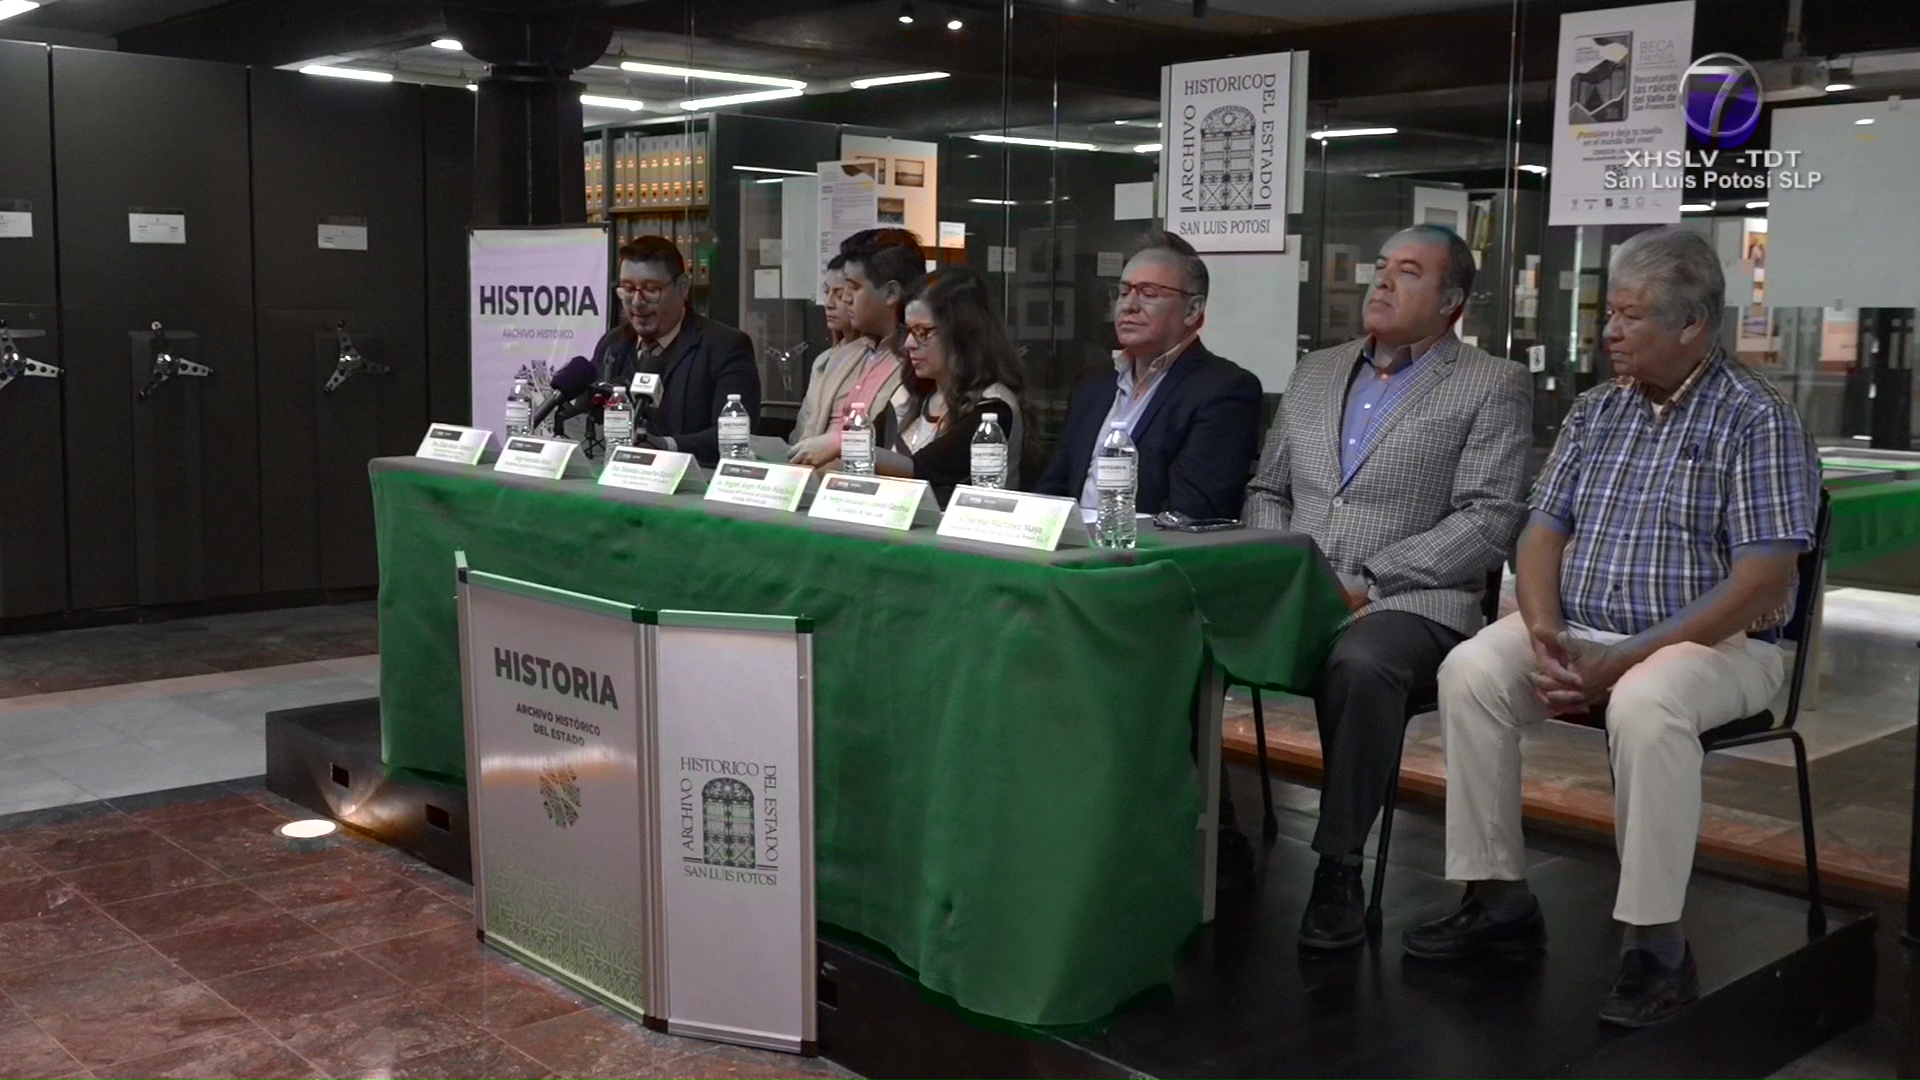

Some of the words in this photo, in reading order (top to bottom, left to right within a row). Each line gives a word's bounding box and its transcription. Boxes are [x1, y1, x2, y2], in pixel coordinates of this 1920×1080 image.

[1184, 73, 1264, 96] HISTORICO
[1262, 73, 1276, 114] DEL
[1181, 105, 1197, 201] ARCHIVO
[1259, 120, 1275, 200] ESTADO
[1179, 221, 1200, 235] SAN
[1203, 220, 1228, 234] LUIS
[1230, 219, 1271, 234] POTOSI
[479, 285, 599, 316] HISTORIA
[502, 329, 535, 339] ARCHIVO
[494, 647, 619, 710] HISTORIA
[516, 703, 553, 722] ARCHIVO
[555, 713, 601, 736] HISTÓRICO
[533, 723, 549, 737] DEL
[551, 728, 585, 746] ESTADO
[680, 756, 760, 777] HISTORICO
[764, 765, 777, 794] DEL
[680, 778, 694, 851] ARCHIVO
[764, 798, 779, 862] ESTADO
[683, 865, 708, 879] SAN
[709, 868, 735, 881] LUIS
[736, 871, 777, 886] POTOSI
